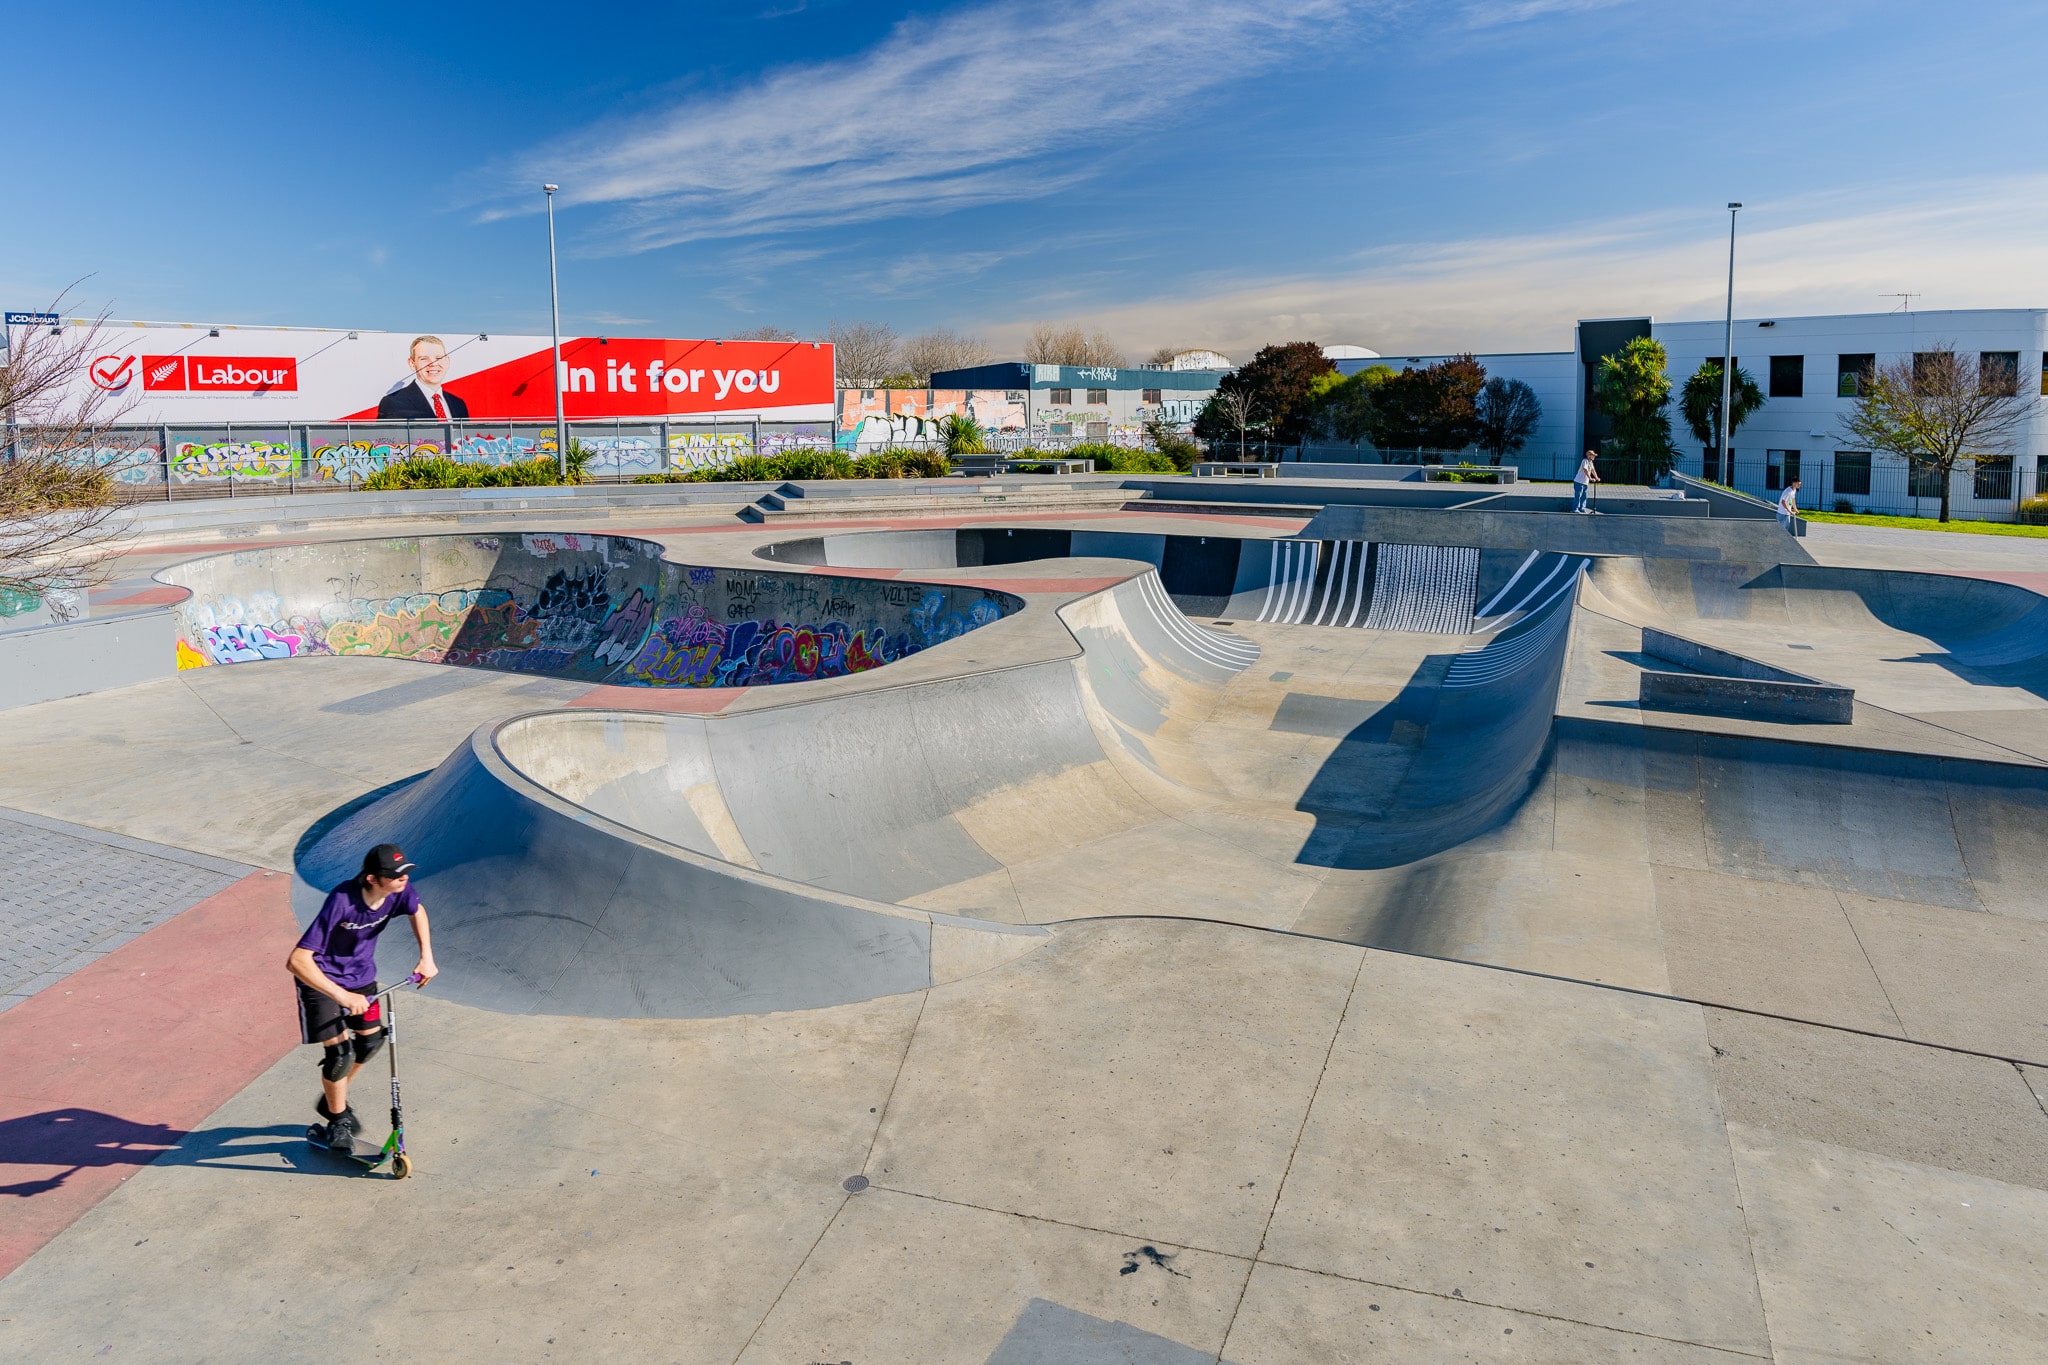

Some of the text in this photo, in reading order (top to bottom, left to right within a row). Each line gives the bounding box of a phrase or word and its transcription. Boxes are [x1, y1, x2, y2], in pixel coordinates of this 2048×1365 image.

[197, 364, 289, 385] Labour
[559, 359, 780, 401] In it for you
